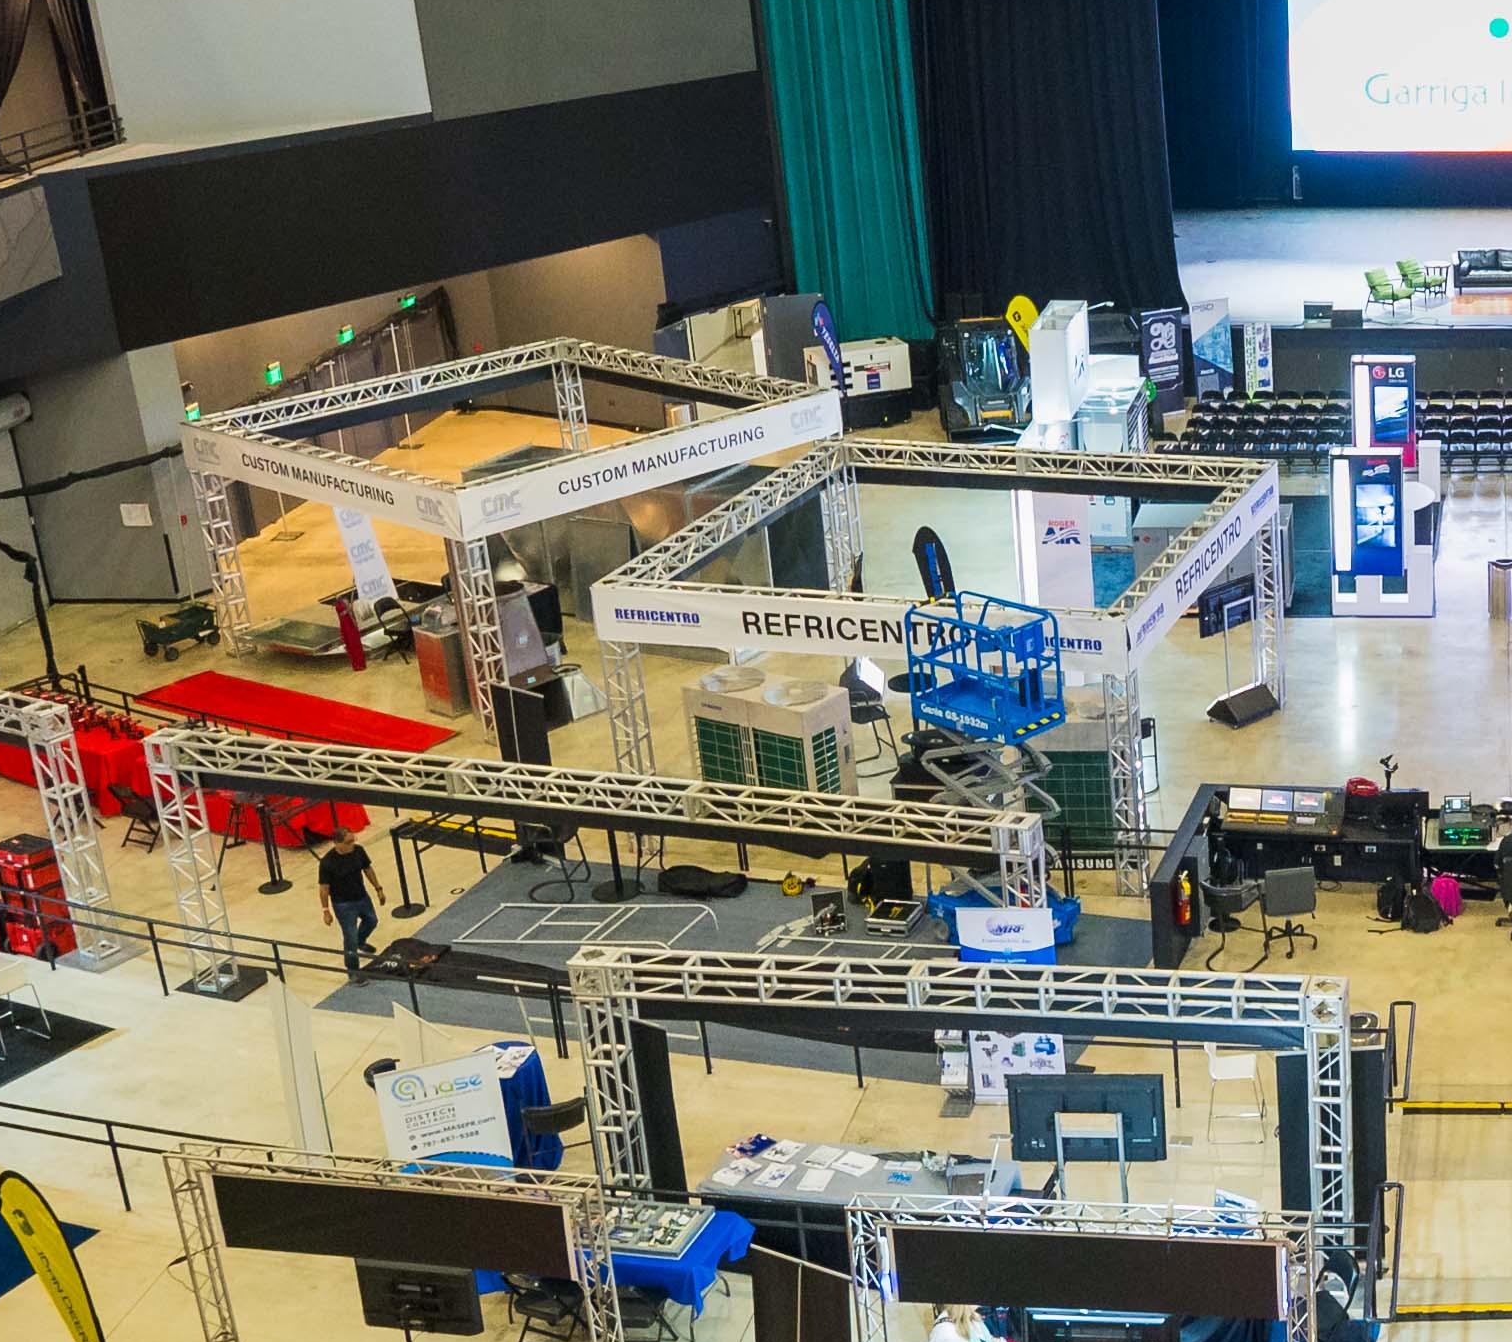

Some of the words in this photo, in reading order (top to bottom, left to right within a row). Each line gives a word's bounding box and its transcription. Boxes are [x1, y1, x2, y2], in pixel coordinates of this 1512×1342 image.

[1365, 72, 1487, 112] Garriga
[1388, 367, 1405, 378] LG
[241, 452, 289, 478] CUSTOM
[291, 465, 395, 506] MANUFACTURING
[558, 463, 628, 496] CUSTOM
[631, 425, 765, 476] MANUFACTURING
[1175, 515, 1242, 603] REFRICENTRO
[614, 607, 701, 625] REFRICENTRO
[741, 611, 972, 648] REFRICENTRO
[996, 924, 1024, 934] MRF
[405, 1106, 456, 1124] DISTECH
